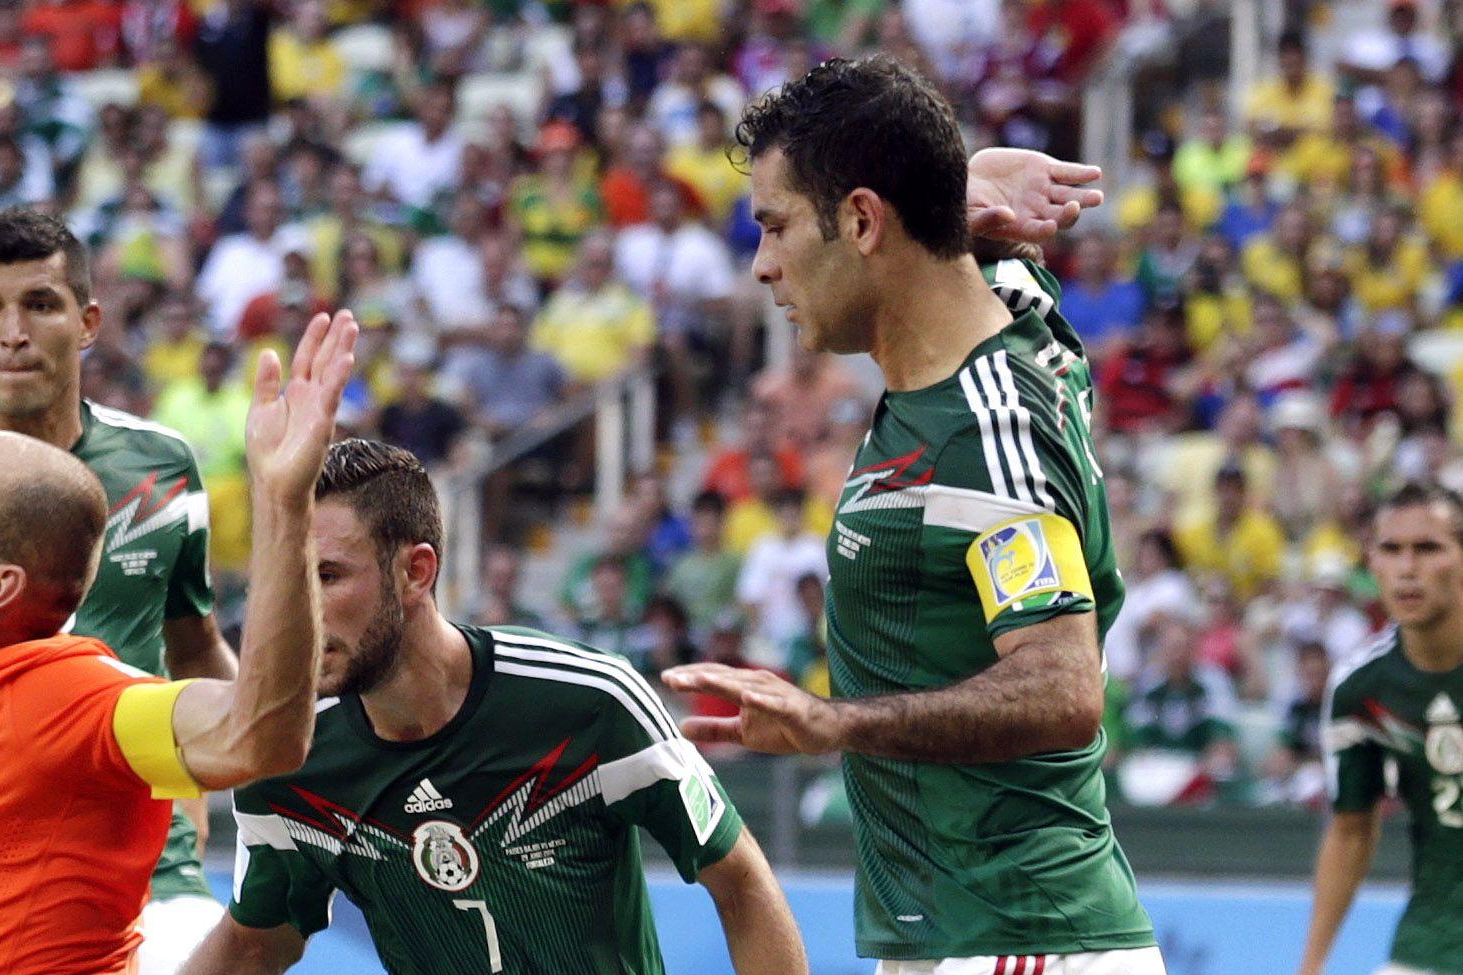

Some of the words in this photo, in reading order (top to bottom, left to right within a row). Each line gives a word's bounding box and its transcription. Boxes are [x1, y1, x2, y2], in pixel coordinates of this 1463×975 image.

[404, 797, 453, 814] adidas
[1431, 777, 1463, 829] 2
[453, 899, 503, 974] 7
